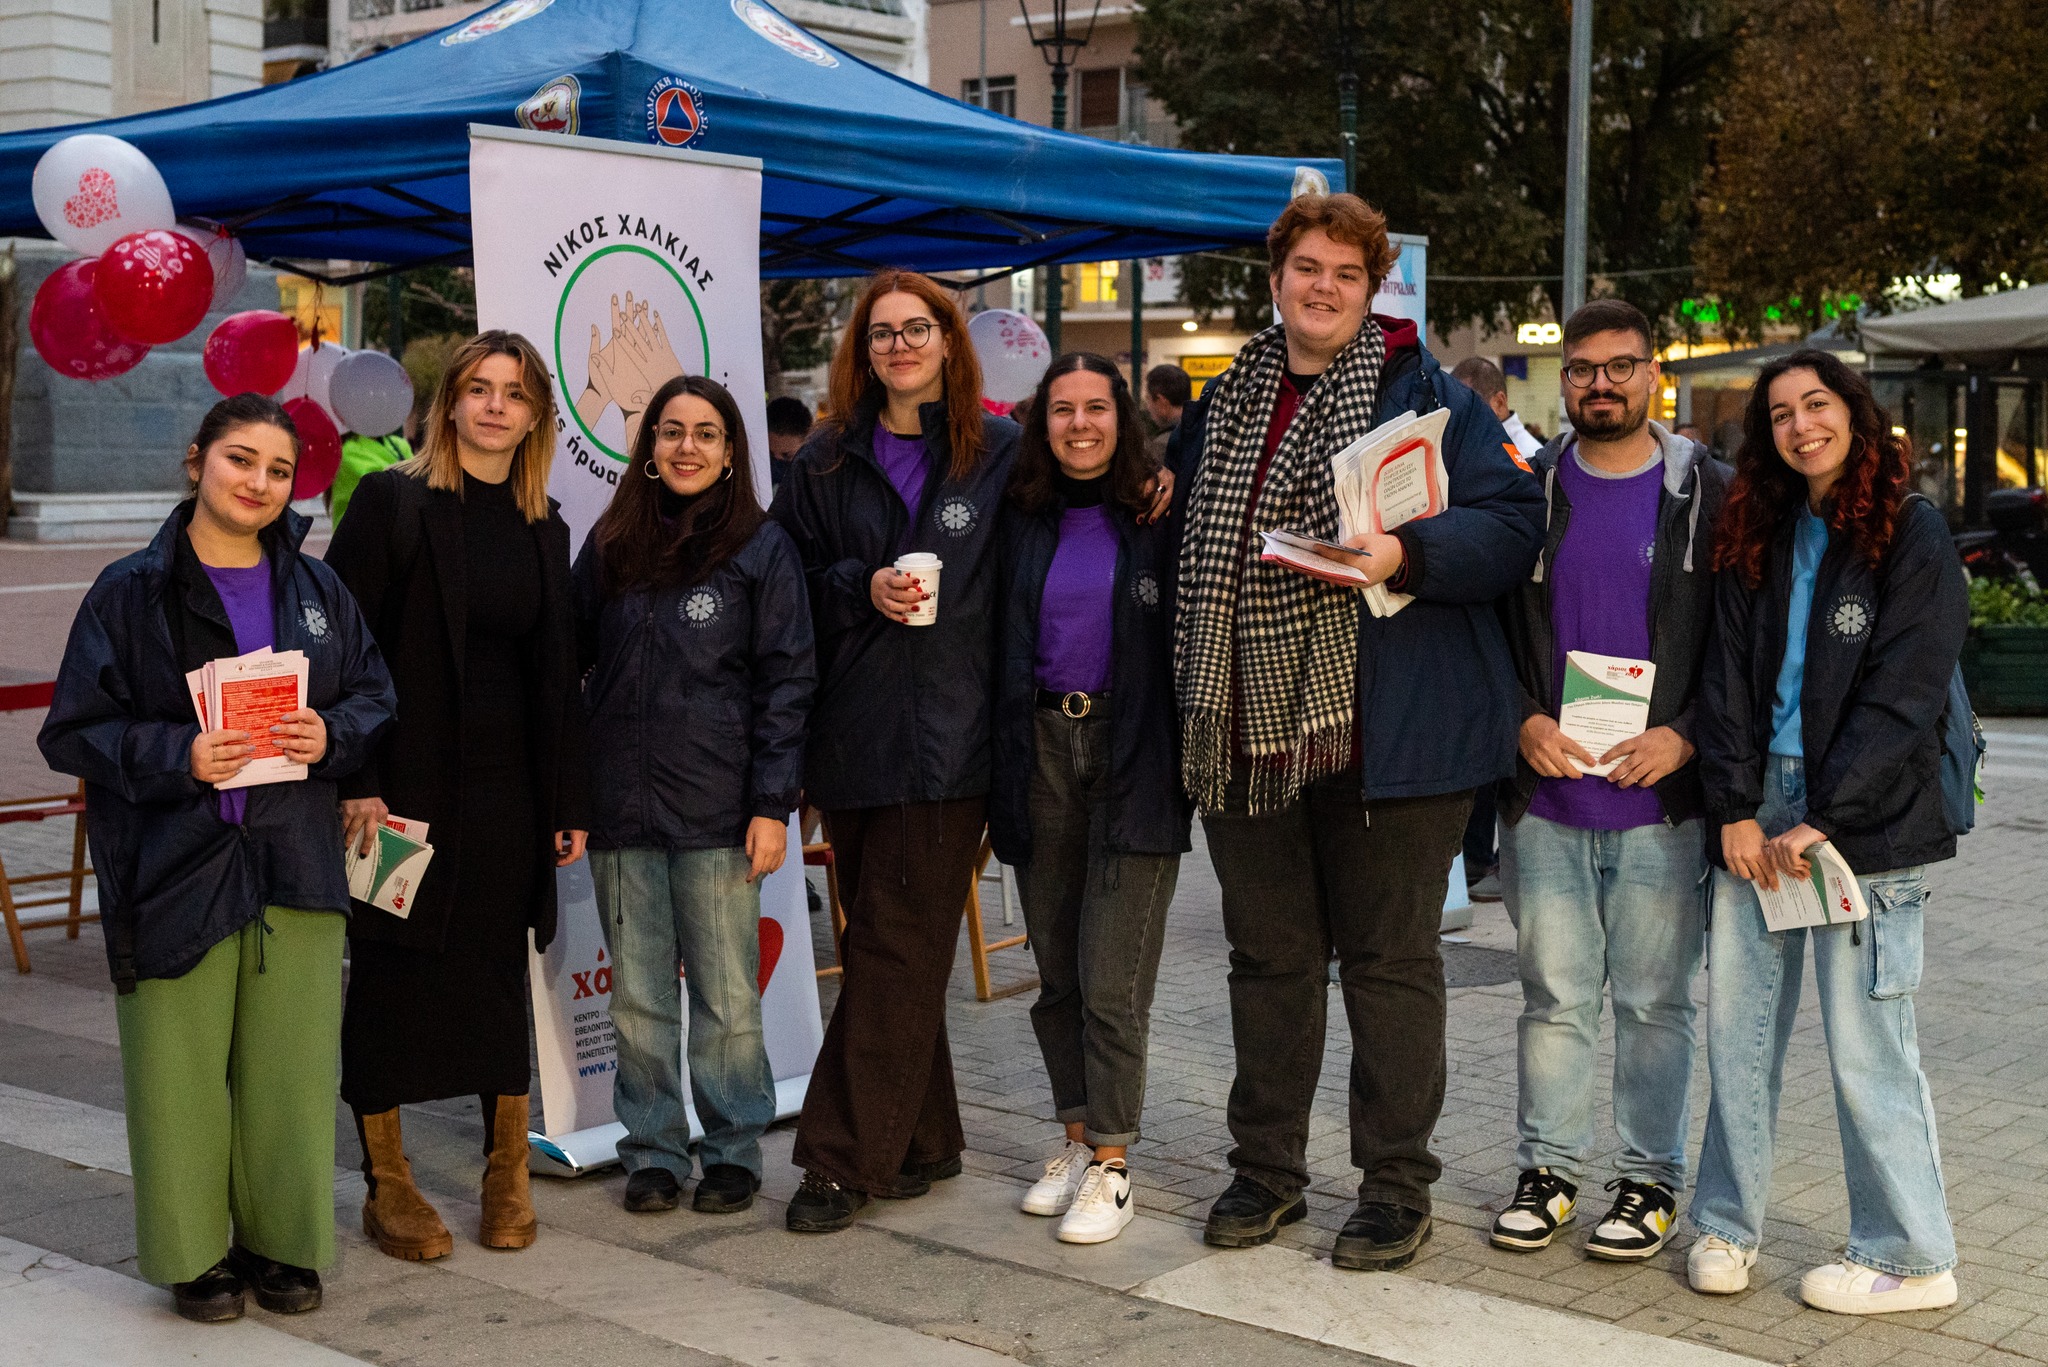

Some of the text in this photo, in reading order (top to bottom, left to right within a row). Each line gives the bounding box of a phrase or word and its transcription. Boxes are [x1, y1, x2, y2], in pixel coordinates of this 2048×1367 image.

[647, 76, 672, 131] ΠΟΛΙΤΙΚΗ
[674, 77, 708, 136] ΠΡΟΣΤΑΣΙΑ
[544, 214, 714, 292] ΝΙΚΟΣ ΧΑΛΚΙΑΣ
[566, 436, 623, 486] ήρωα
[574, 1010, 600, 1024] ΚΕΝΤΡΟ
[574, 1020, 614, 1036] ΕΘΕΛΟΝΤΩΝ
[576, 1034, 602, 1048] ΜΥΕΛΟΥ
